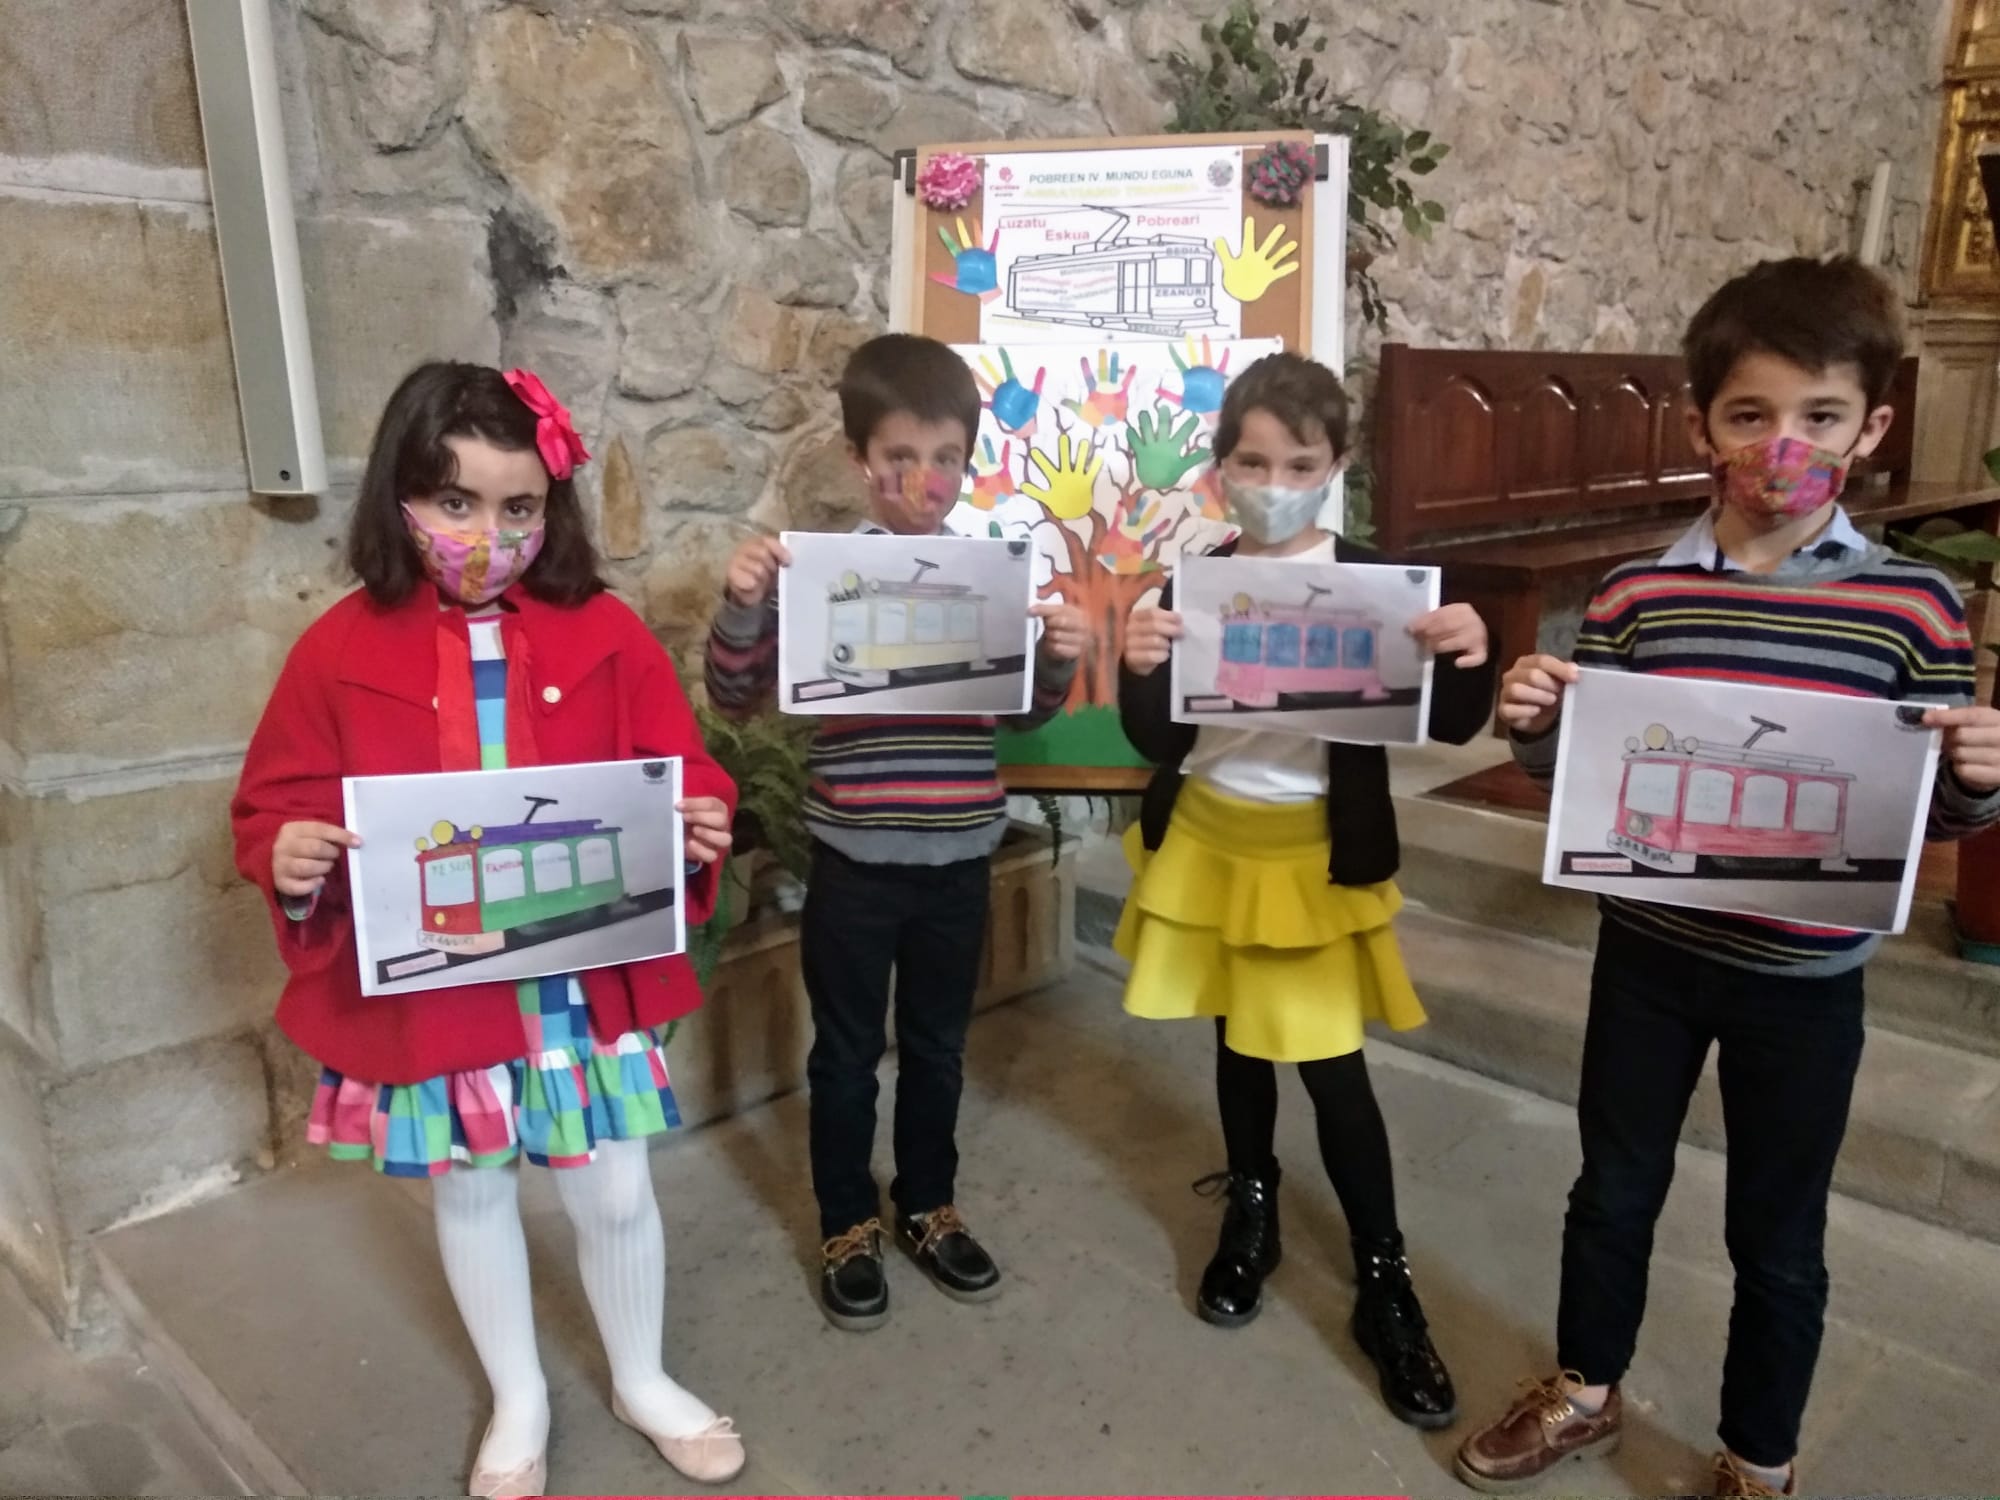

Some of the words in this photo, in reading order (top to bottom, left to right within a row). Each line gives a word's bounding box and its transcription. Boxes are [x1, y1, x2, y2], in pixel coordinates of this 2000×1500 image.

[1029, 172, 1088, 184] POBREEN
[1105, 169, 1150, 182] MUNDU
[1152, 168, 1193, 180] EGUNA
[998, 217, 1046, 229] Luzatu
[1136, 215, 1201, 227] Pobreari
[1045, 229, 1090, 241] Eskua
[1155, 288, 1206, 298] ZEANURI
